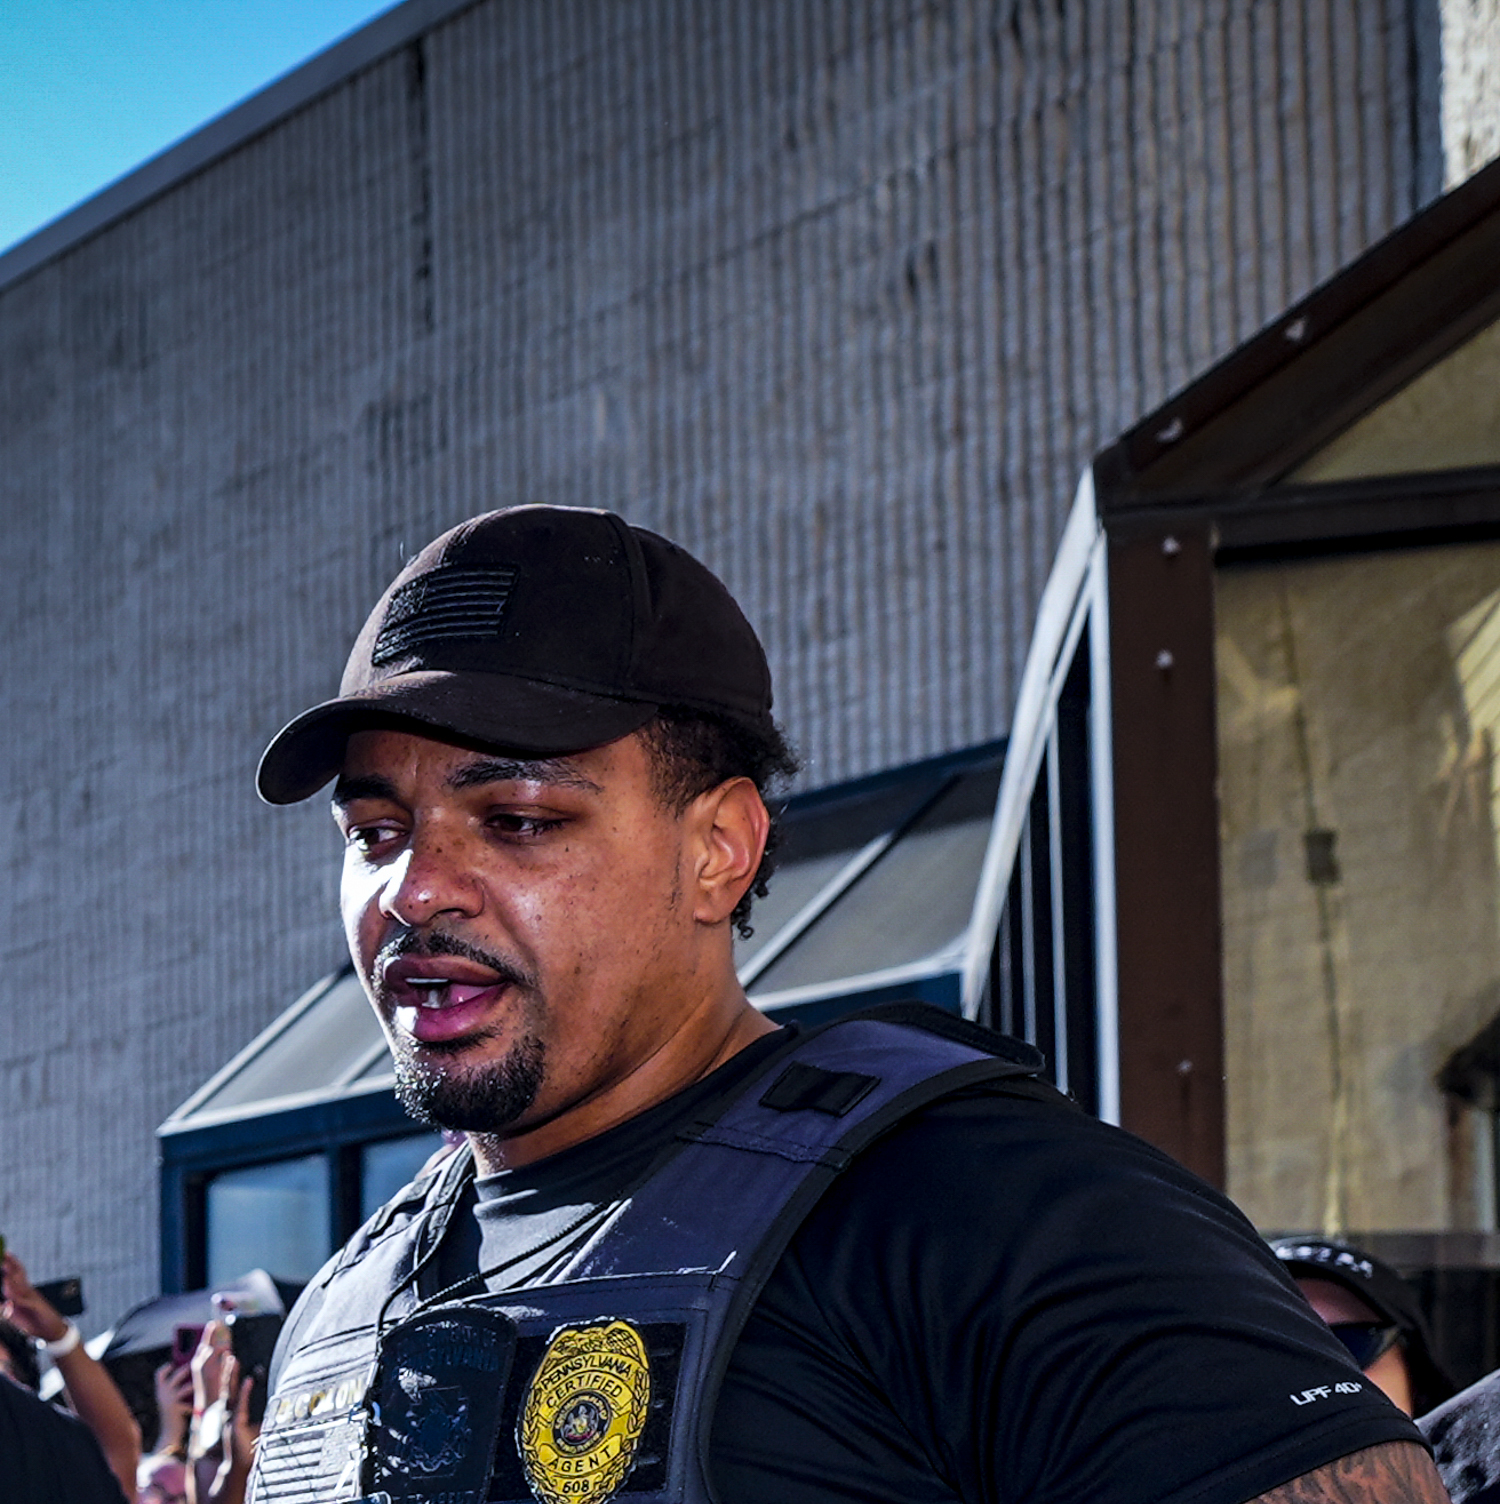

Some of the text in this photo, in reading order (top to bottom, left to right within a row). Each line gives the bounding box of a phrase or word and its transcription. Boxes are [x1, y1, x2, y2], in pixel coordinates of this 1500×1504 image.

[540, 1354, 633, 1390] PENNSYLVANIA
[545, 1375, 624, 1409] CERTIFIED
[1289, 1384, 1333, 1406] UPF
[549, 1446, 612, 1473] AGENT
